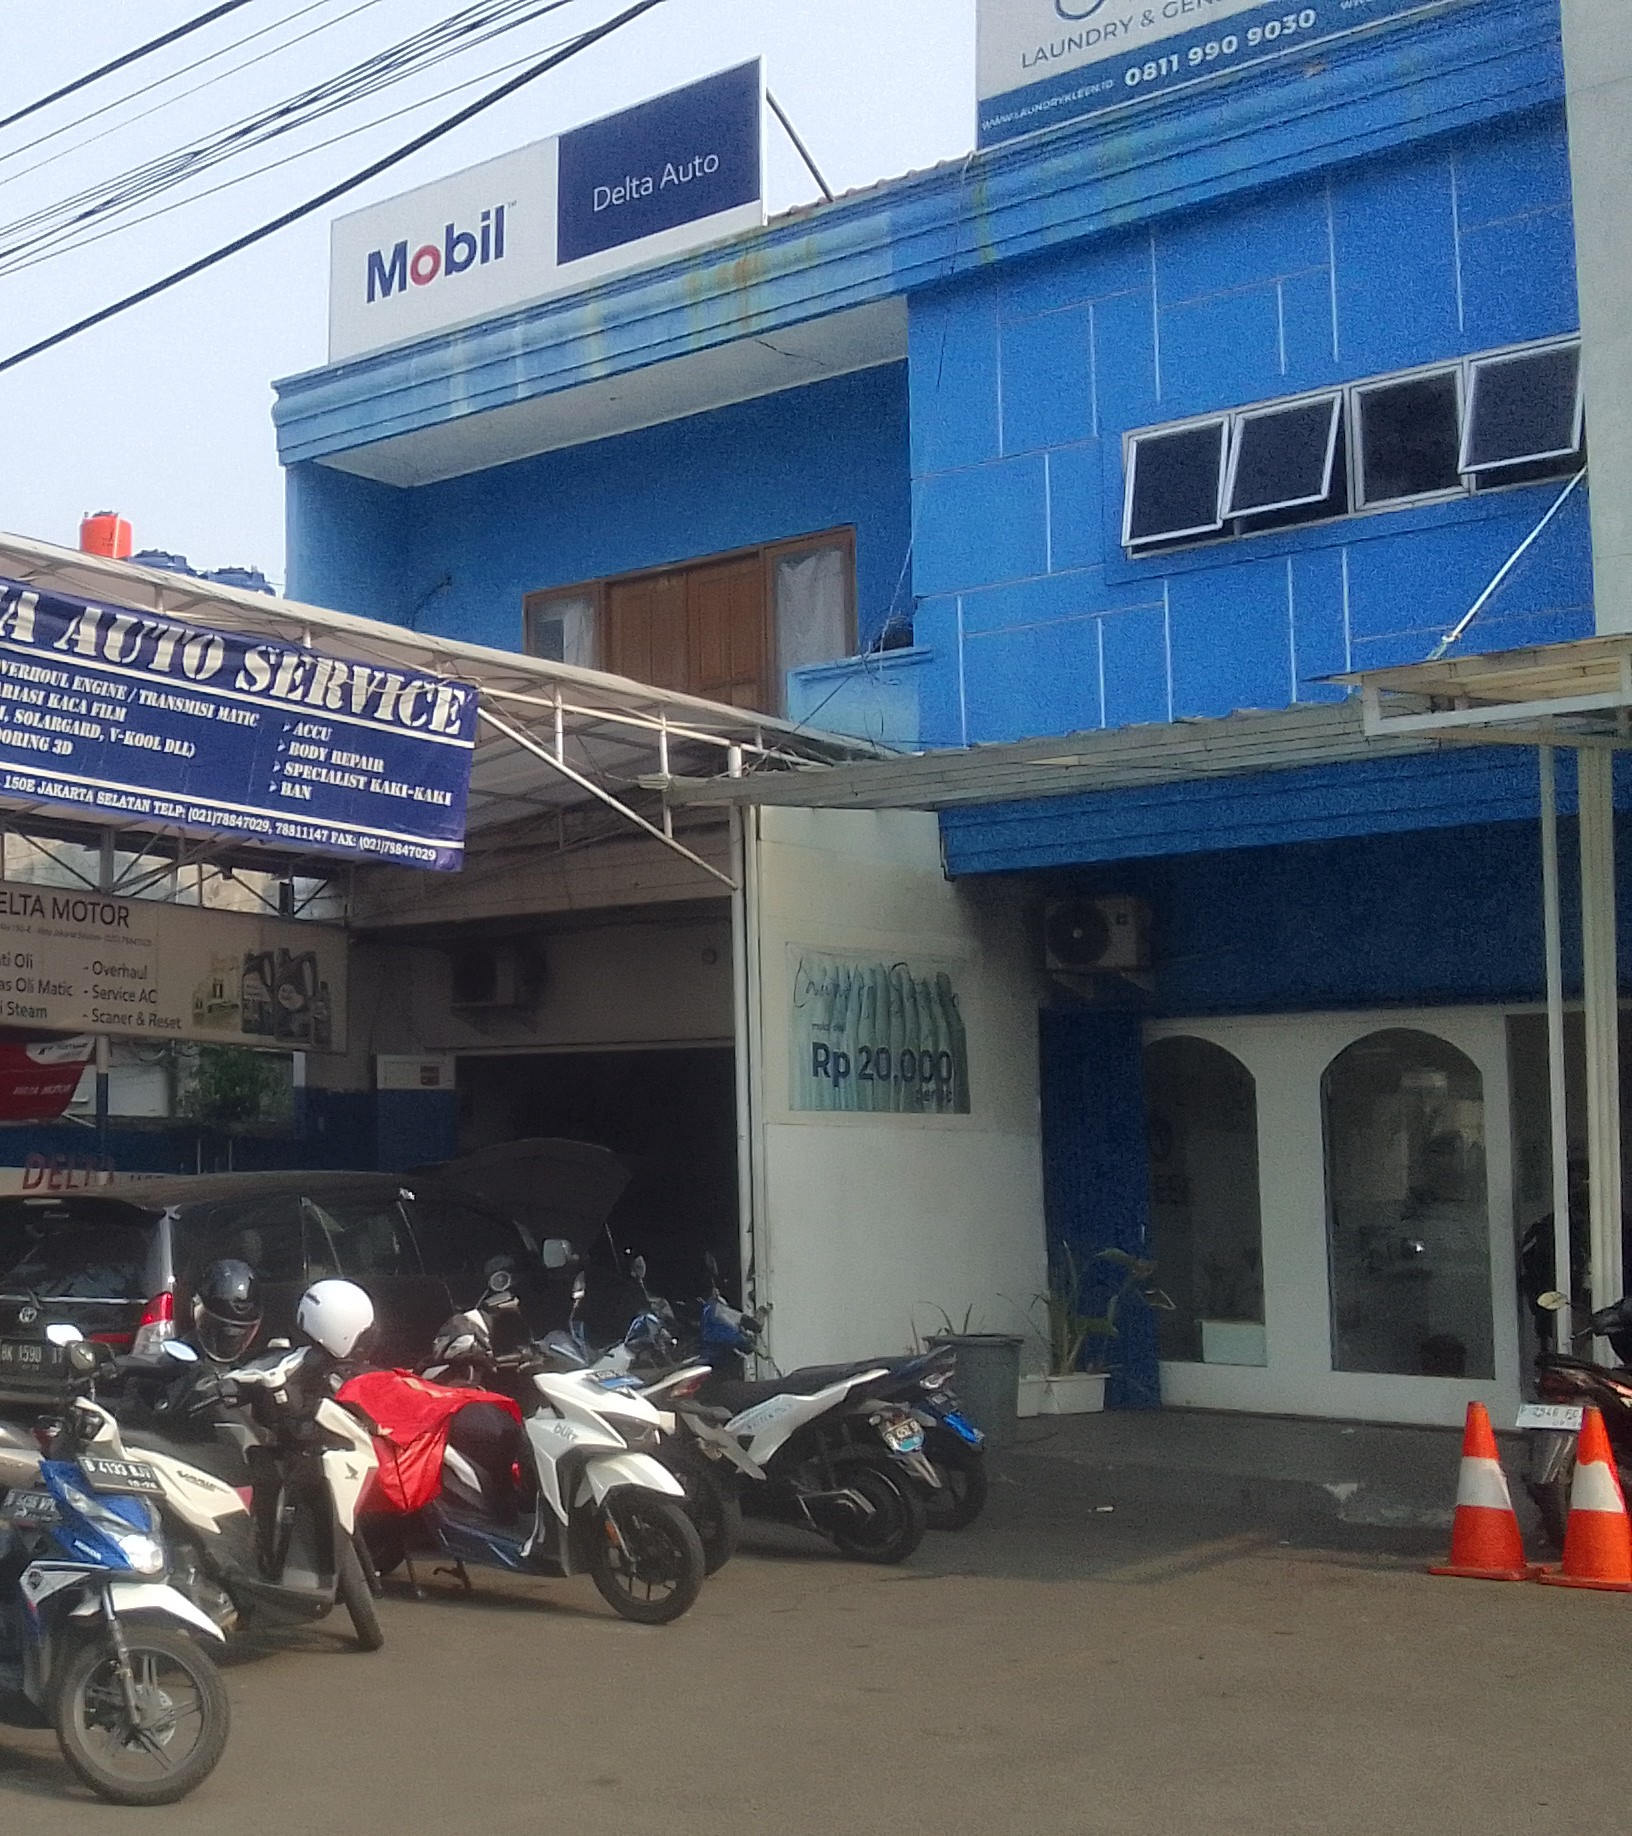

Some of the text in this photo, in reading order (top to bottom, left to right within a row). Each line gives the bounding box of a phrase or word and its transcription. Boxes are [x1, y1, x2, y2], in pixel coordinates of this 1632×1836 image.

[1021, 16, 1134, 69] LAUNDRY
[1139, 8, 1156, 28] &
[1123, 8, 1317, 87] 0811 990 9030
[592, 152, 720, 212] Delta Auto
[366, 204, 506, 304] Mobil
[53, 606, 225, 681] AUTO
[235, 644, 466, 735] SERVICE
[47, 693, 88, 716] KACA
[90, 702, 127, 722] FILM
[73, 677, 126, 702] ENGINE
[138, 688, 215, 719] TRANSMISI
[218, 705, 260, 728] MATIC
[52, 739, 74, 756] 3D
[109, 726, 164, 754] V-KOOL
[165, 737, 196, 759] DLL)
[293, 721, 333, 742] ACCU
[289, 741, 385, 774] BODY REPAIR
[284, 760, 453, 806] SPECIALIST KAKI-KAKI
[36, 780, 94, 804] JAKARTA
[97, 790, 151, 814] SELATAN
[153, 801, 186, 819] TELP:
[330, 831, 357, 848] FAX:
[51, 897, 130, 929] MOTOR
[14, 952, 34, 969] Oli
[92, 960, 148, 981] Overhaul
[16, 976, 35, 994] Oli
[37, 979, 73, 998] Matic
[92, 984, 158, 1004] Service AC
[6, 1001, 48, 1020] Steam
[91, 1009, 183, 1031] Scaner & Reset
[811, 1041, 851, 1088] Rp
